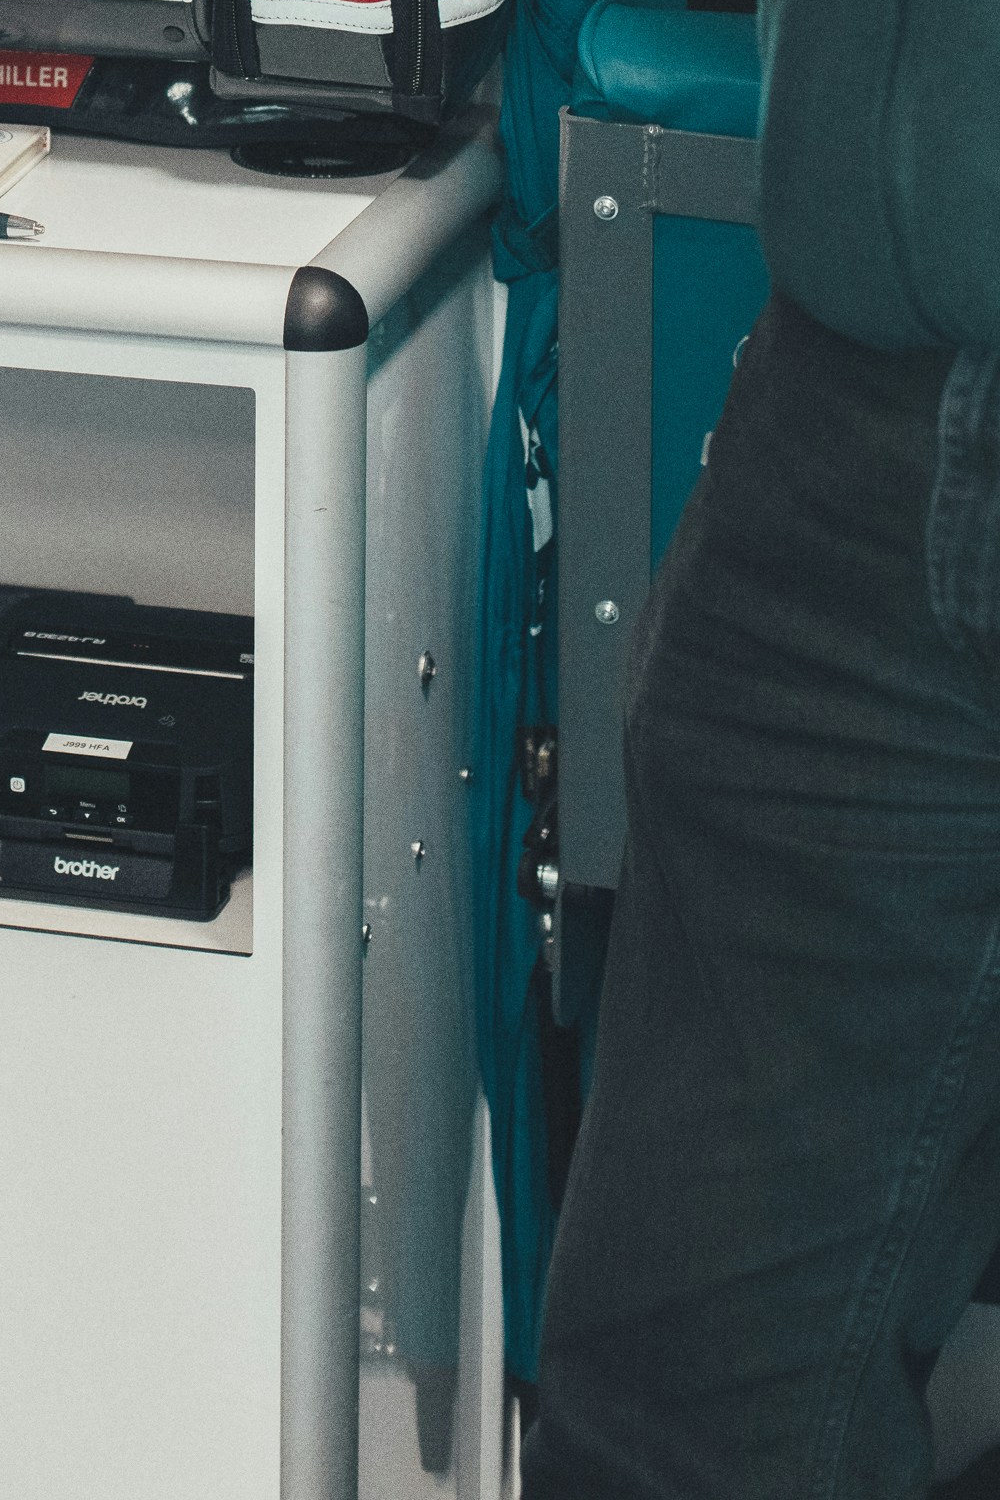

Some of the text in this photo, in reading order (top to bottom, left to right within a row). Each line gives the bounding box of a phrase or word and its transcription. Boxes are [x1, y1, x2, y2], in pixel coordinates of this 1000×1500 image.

[78, 691, 148, 709] brother
[63, 741, 110, 751] J999 HFA
[53, 856, 120, 881] brother
